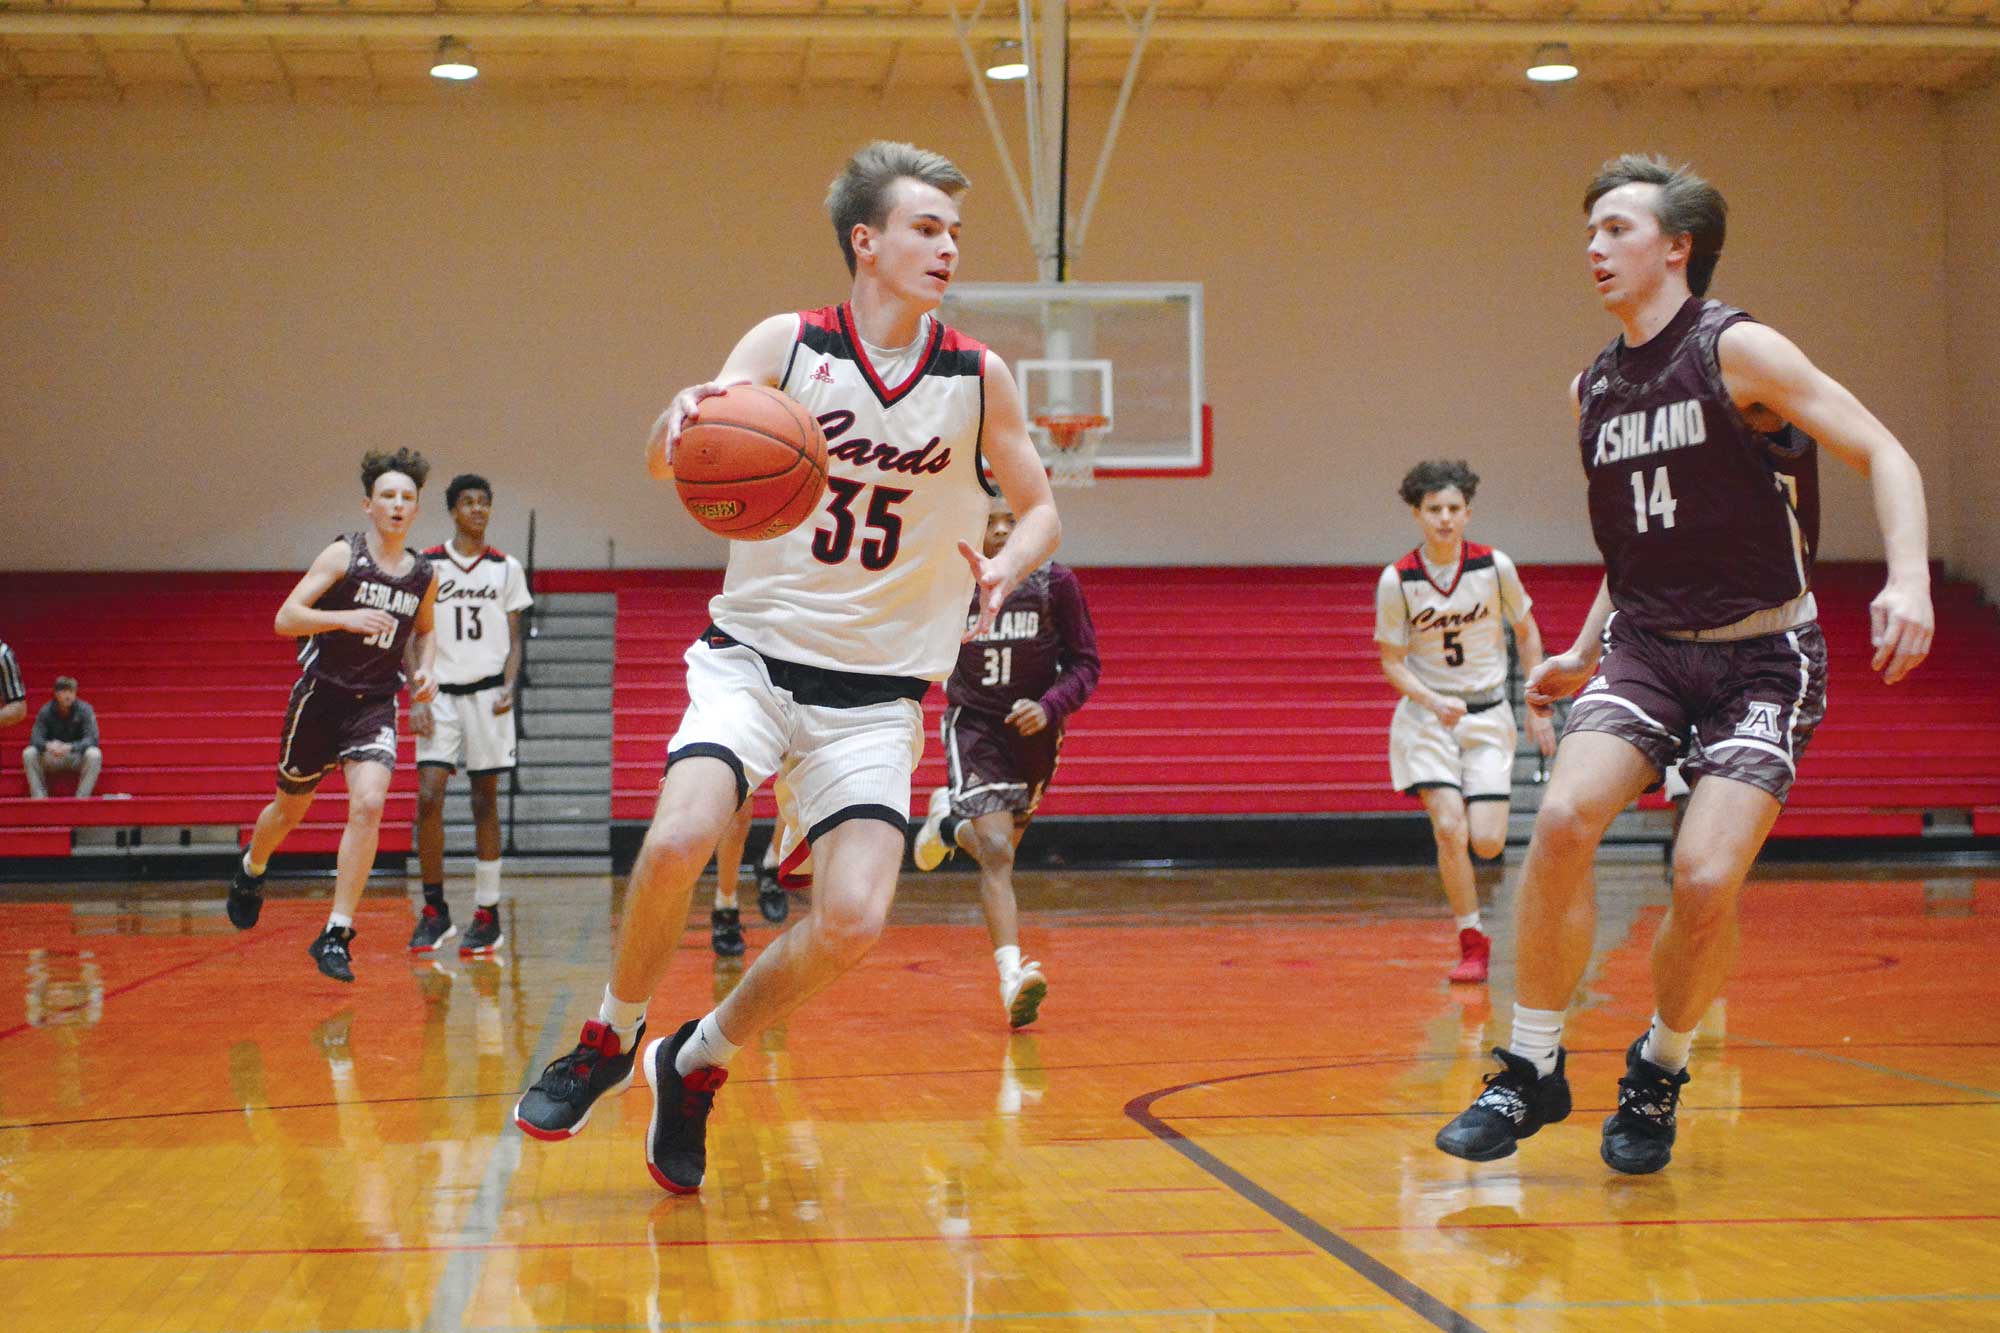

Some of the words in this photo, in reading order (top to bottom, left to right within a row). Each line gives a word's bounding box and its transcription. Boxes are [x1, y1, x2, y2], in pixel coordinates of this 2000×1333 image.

[1593, 399, 1706, 467] ASHLAND
[1630, 465, 1677, 533] 14
[811, 476, 914, 571] 35
[353, 580, 420, 617] ASHLAND
[435, 580, 498, 603] Cards
[454, 606, 482, 641] 13
[1409, 603, 1489, 632] Cards
[981, 647, 1012, 686] 31
[1443, 630, 1465, 667] 5
[1734, 701, 1782, 744] A
